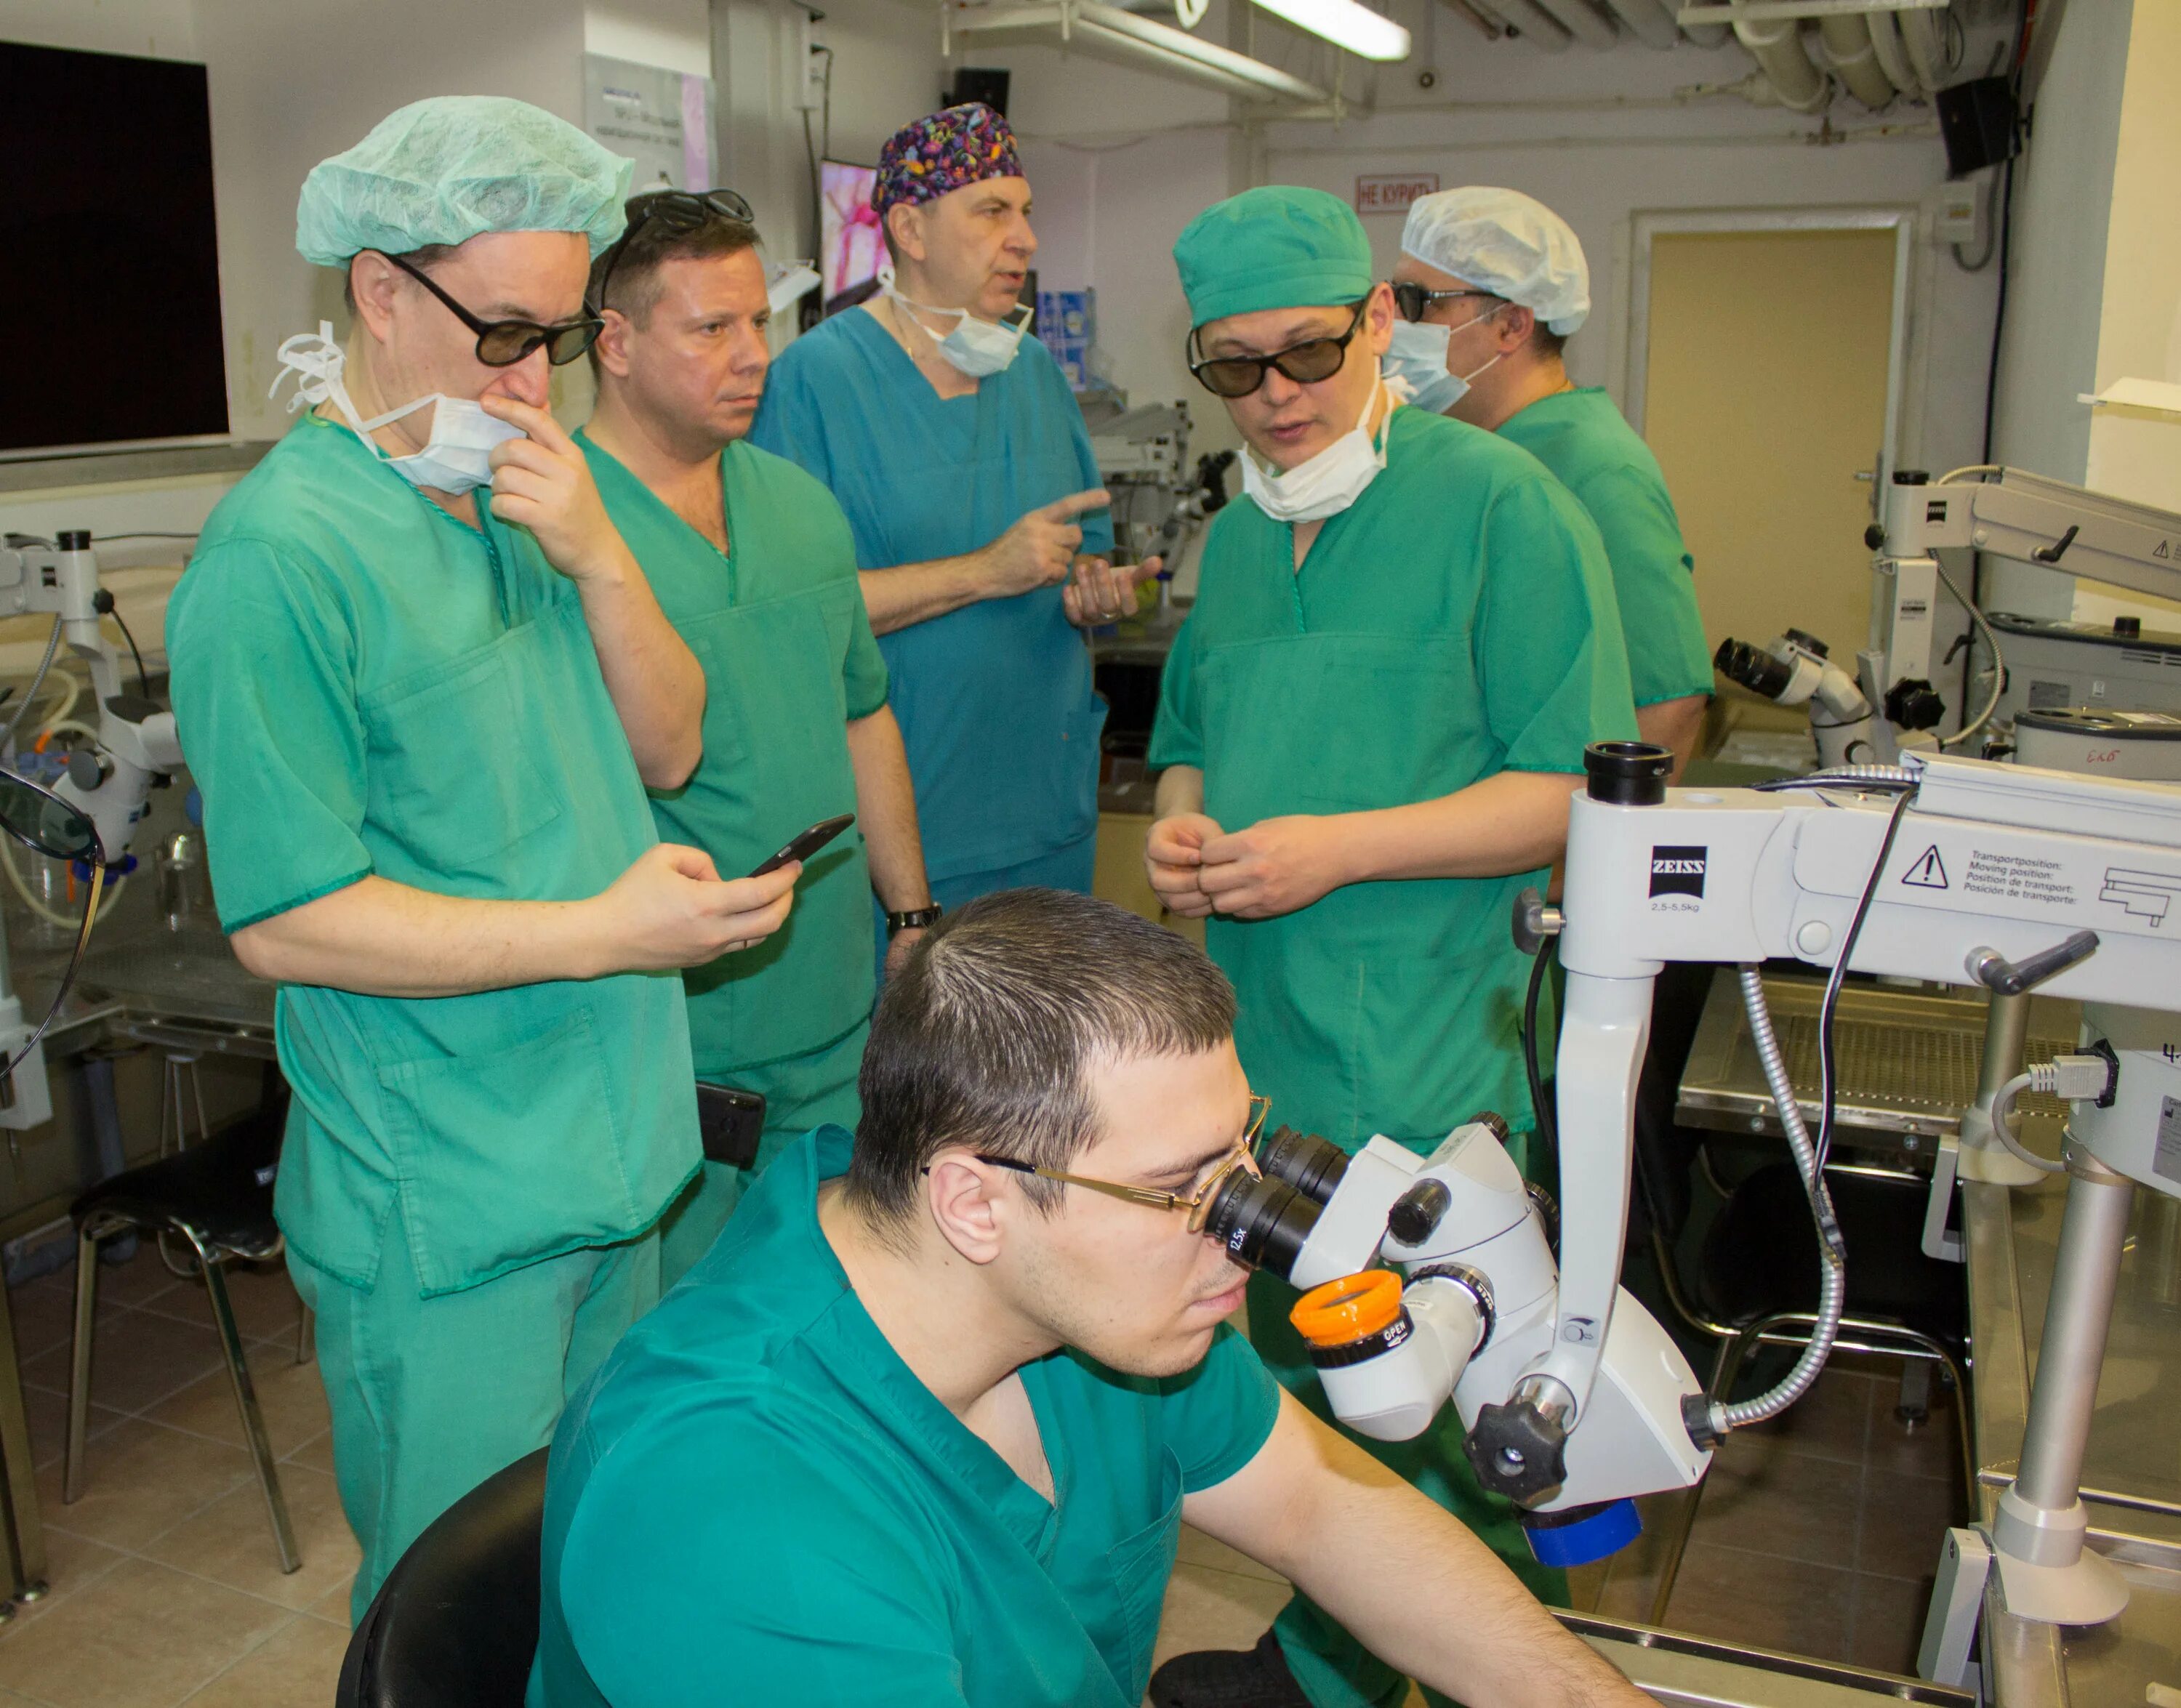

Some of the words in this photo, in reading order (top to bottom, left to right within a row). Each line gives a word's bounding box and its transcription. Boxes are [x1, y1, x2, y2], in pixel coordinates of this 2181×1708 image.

[1361, 184, 1378, 204] НЕ
[1652, 859, 1705, 874] ZEISS
[1969, 861, 2007, 877] Moving
[2009, 867, 2053, 880] position:
[1965, 871, 2007, 885] Position
[2009, 878, 2021, 887] de
[2025, 880, 2073, 894] transport:
[2007, 888, 2020, 898] de
[2023, 890, 2077, 905] transporte:
[1651, 903, 1700, 913] 2,5-5,5kg
[1229, 1227, 1247, 1251] 12,5x
[1383, 1320, 1406, 1341] OPEN
